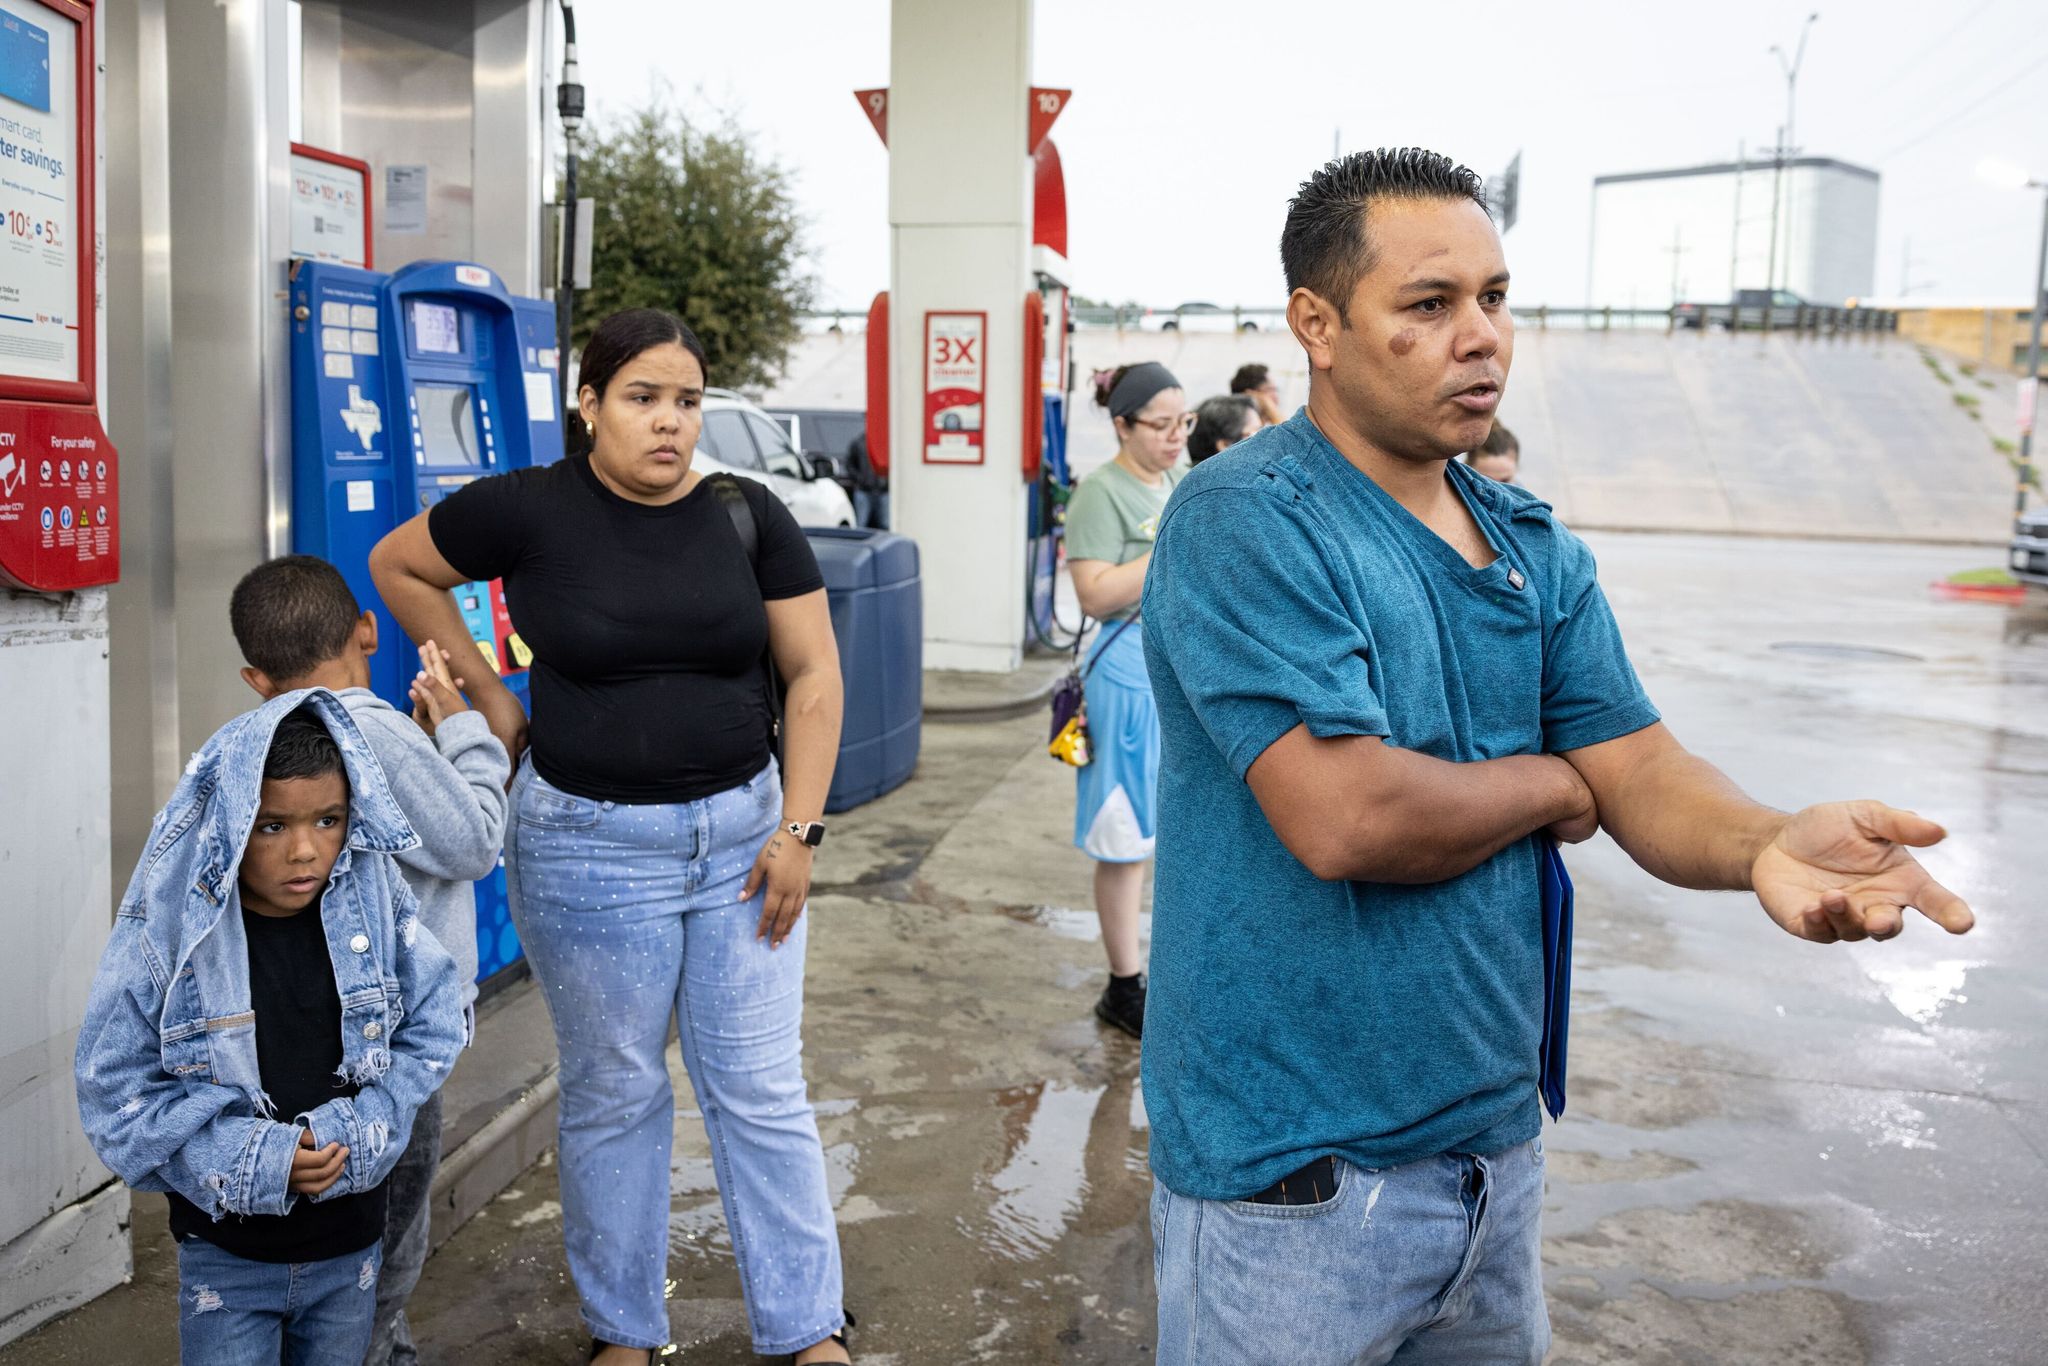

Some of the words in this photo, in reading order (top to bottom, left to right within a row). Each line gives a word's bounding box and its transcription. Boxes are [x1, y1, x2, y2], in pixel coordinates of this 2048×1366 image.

[868, 93, 885, 116] 9
[1037, 93, 1060, 114] 10
[21, 147, 65, 179] savings.
[934, 337, 976, 364] 3X
[51, 436, 62, 448] For
[63, 439, 77, 451] your
[78, 436, 96, 452] safety
